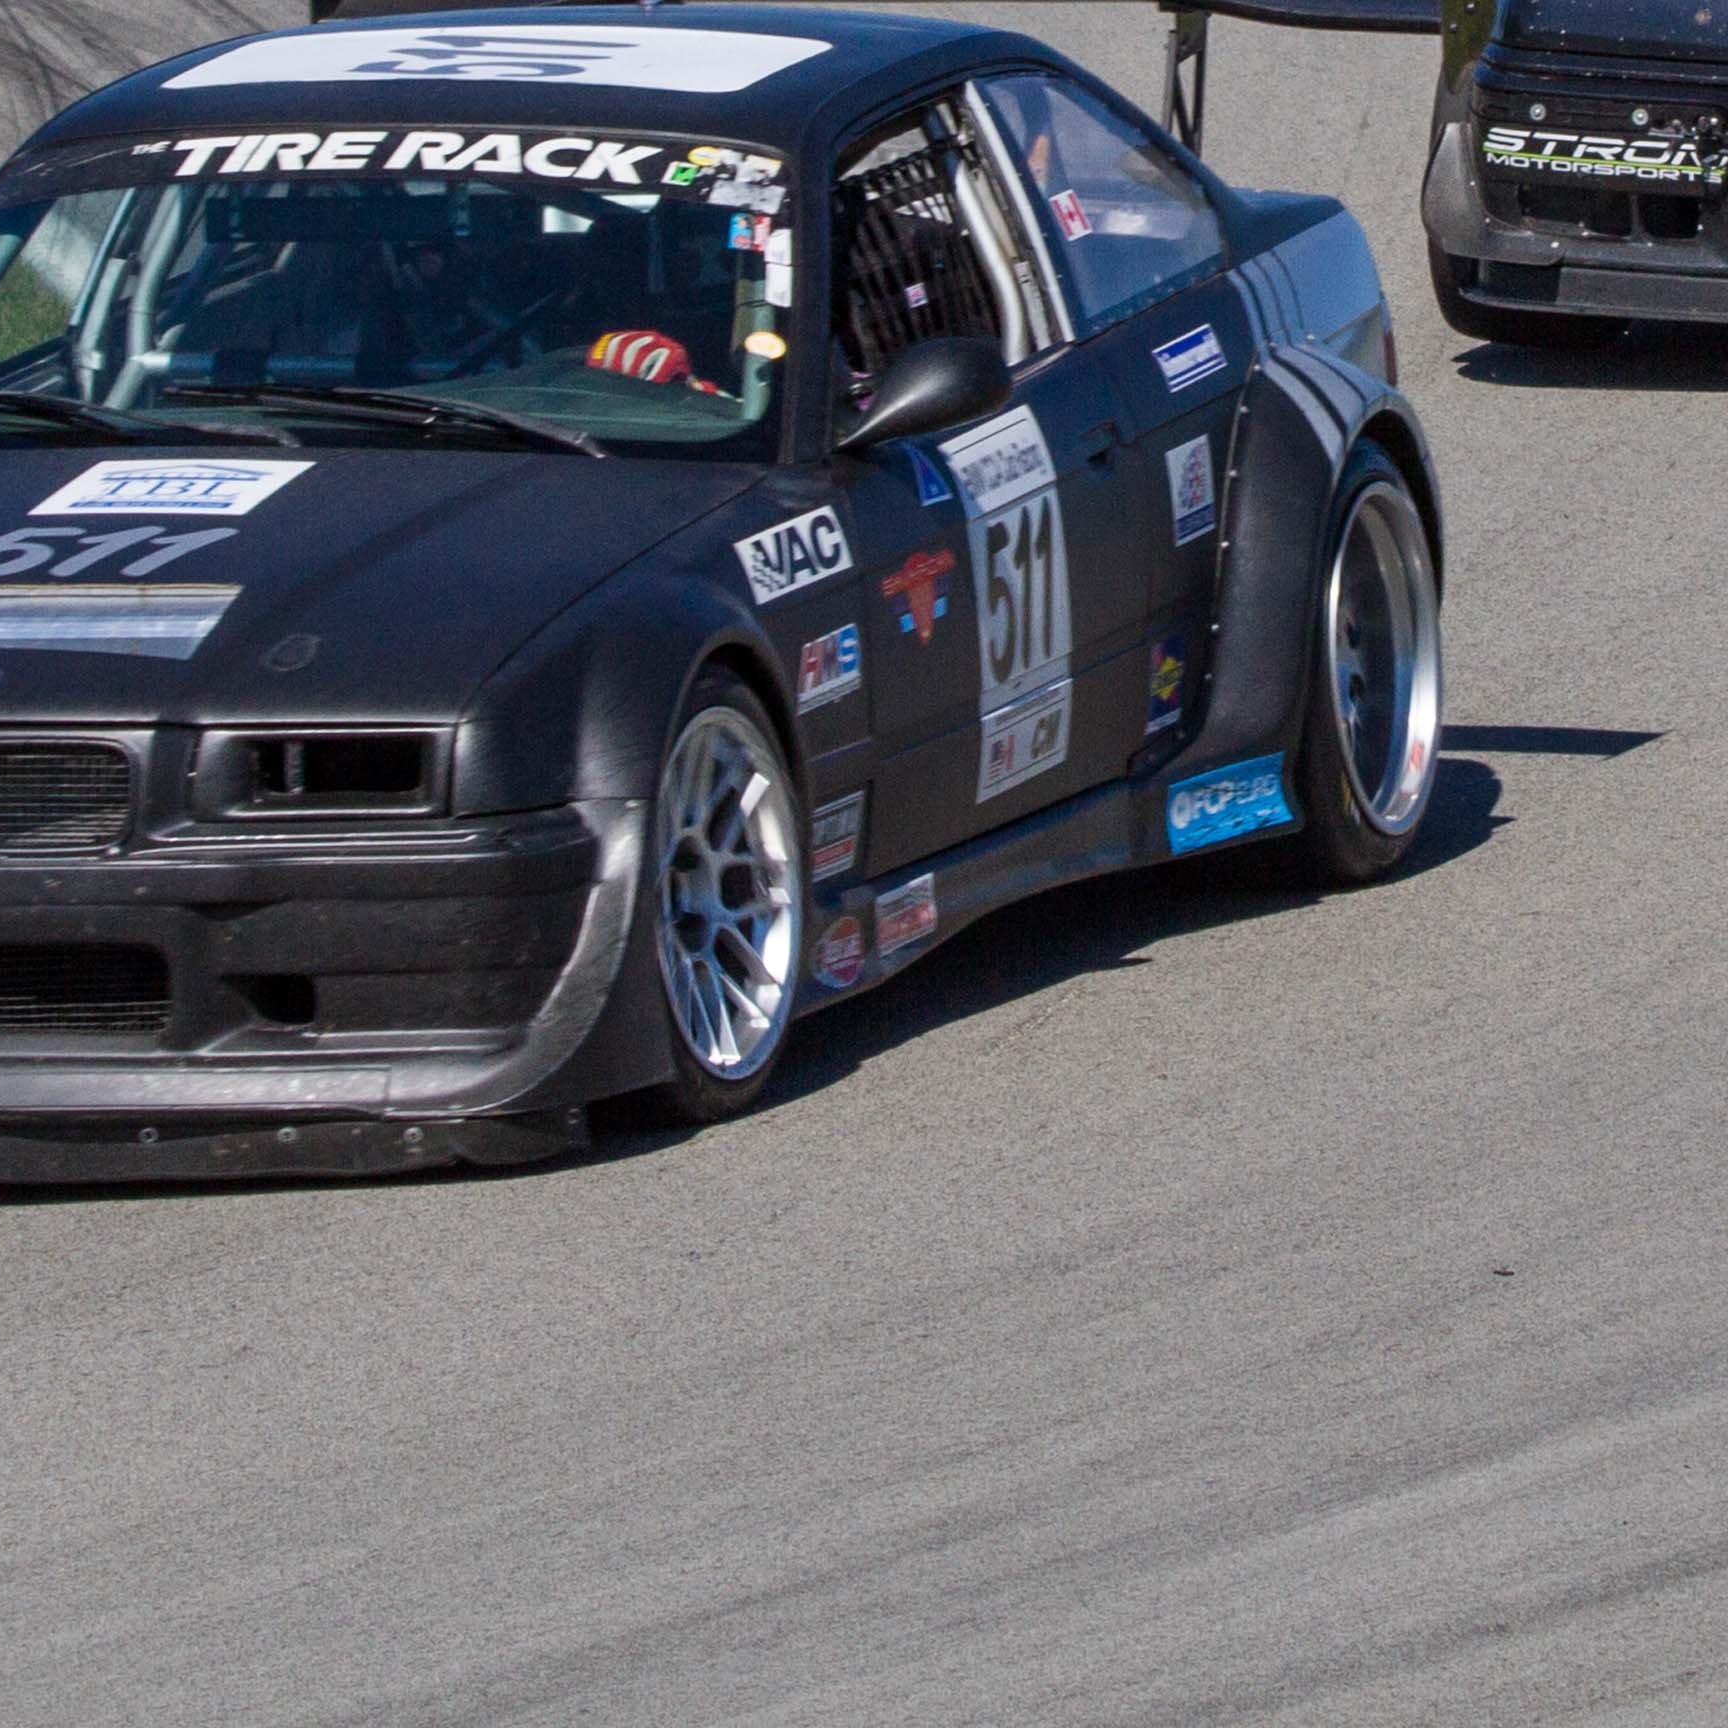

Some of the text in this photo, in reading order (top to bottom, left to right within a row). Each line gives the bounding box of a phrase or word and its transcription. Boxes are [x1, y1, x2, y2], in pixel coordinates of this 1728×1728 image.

[170, 131, 389, 178] TIRE
[381, 131, 664, 185] RACK
[1485, 151, 1724, 185] MOTORSPORTS
[751, 514, 842, 586] VAC
[985, 495, 1053, 685] 511
[798, 626, 862, 694] HMS
